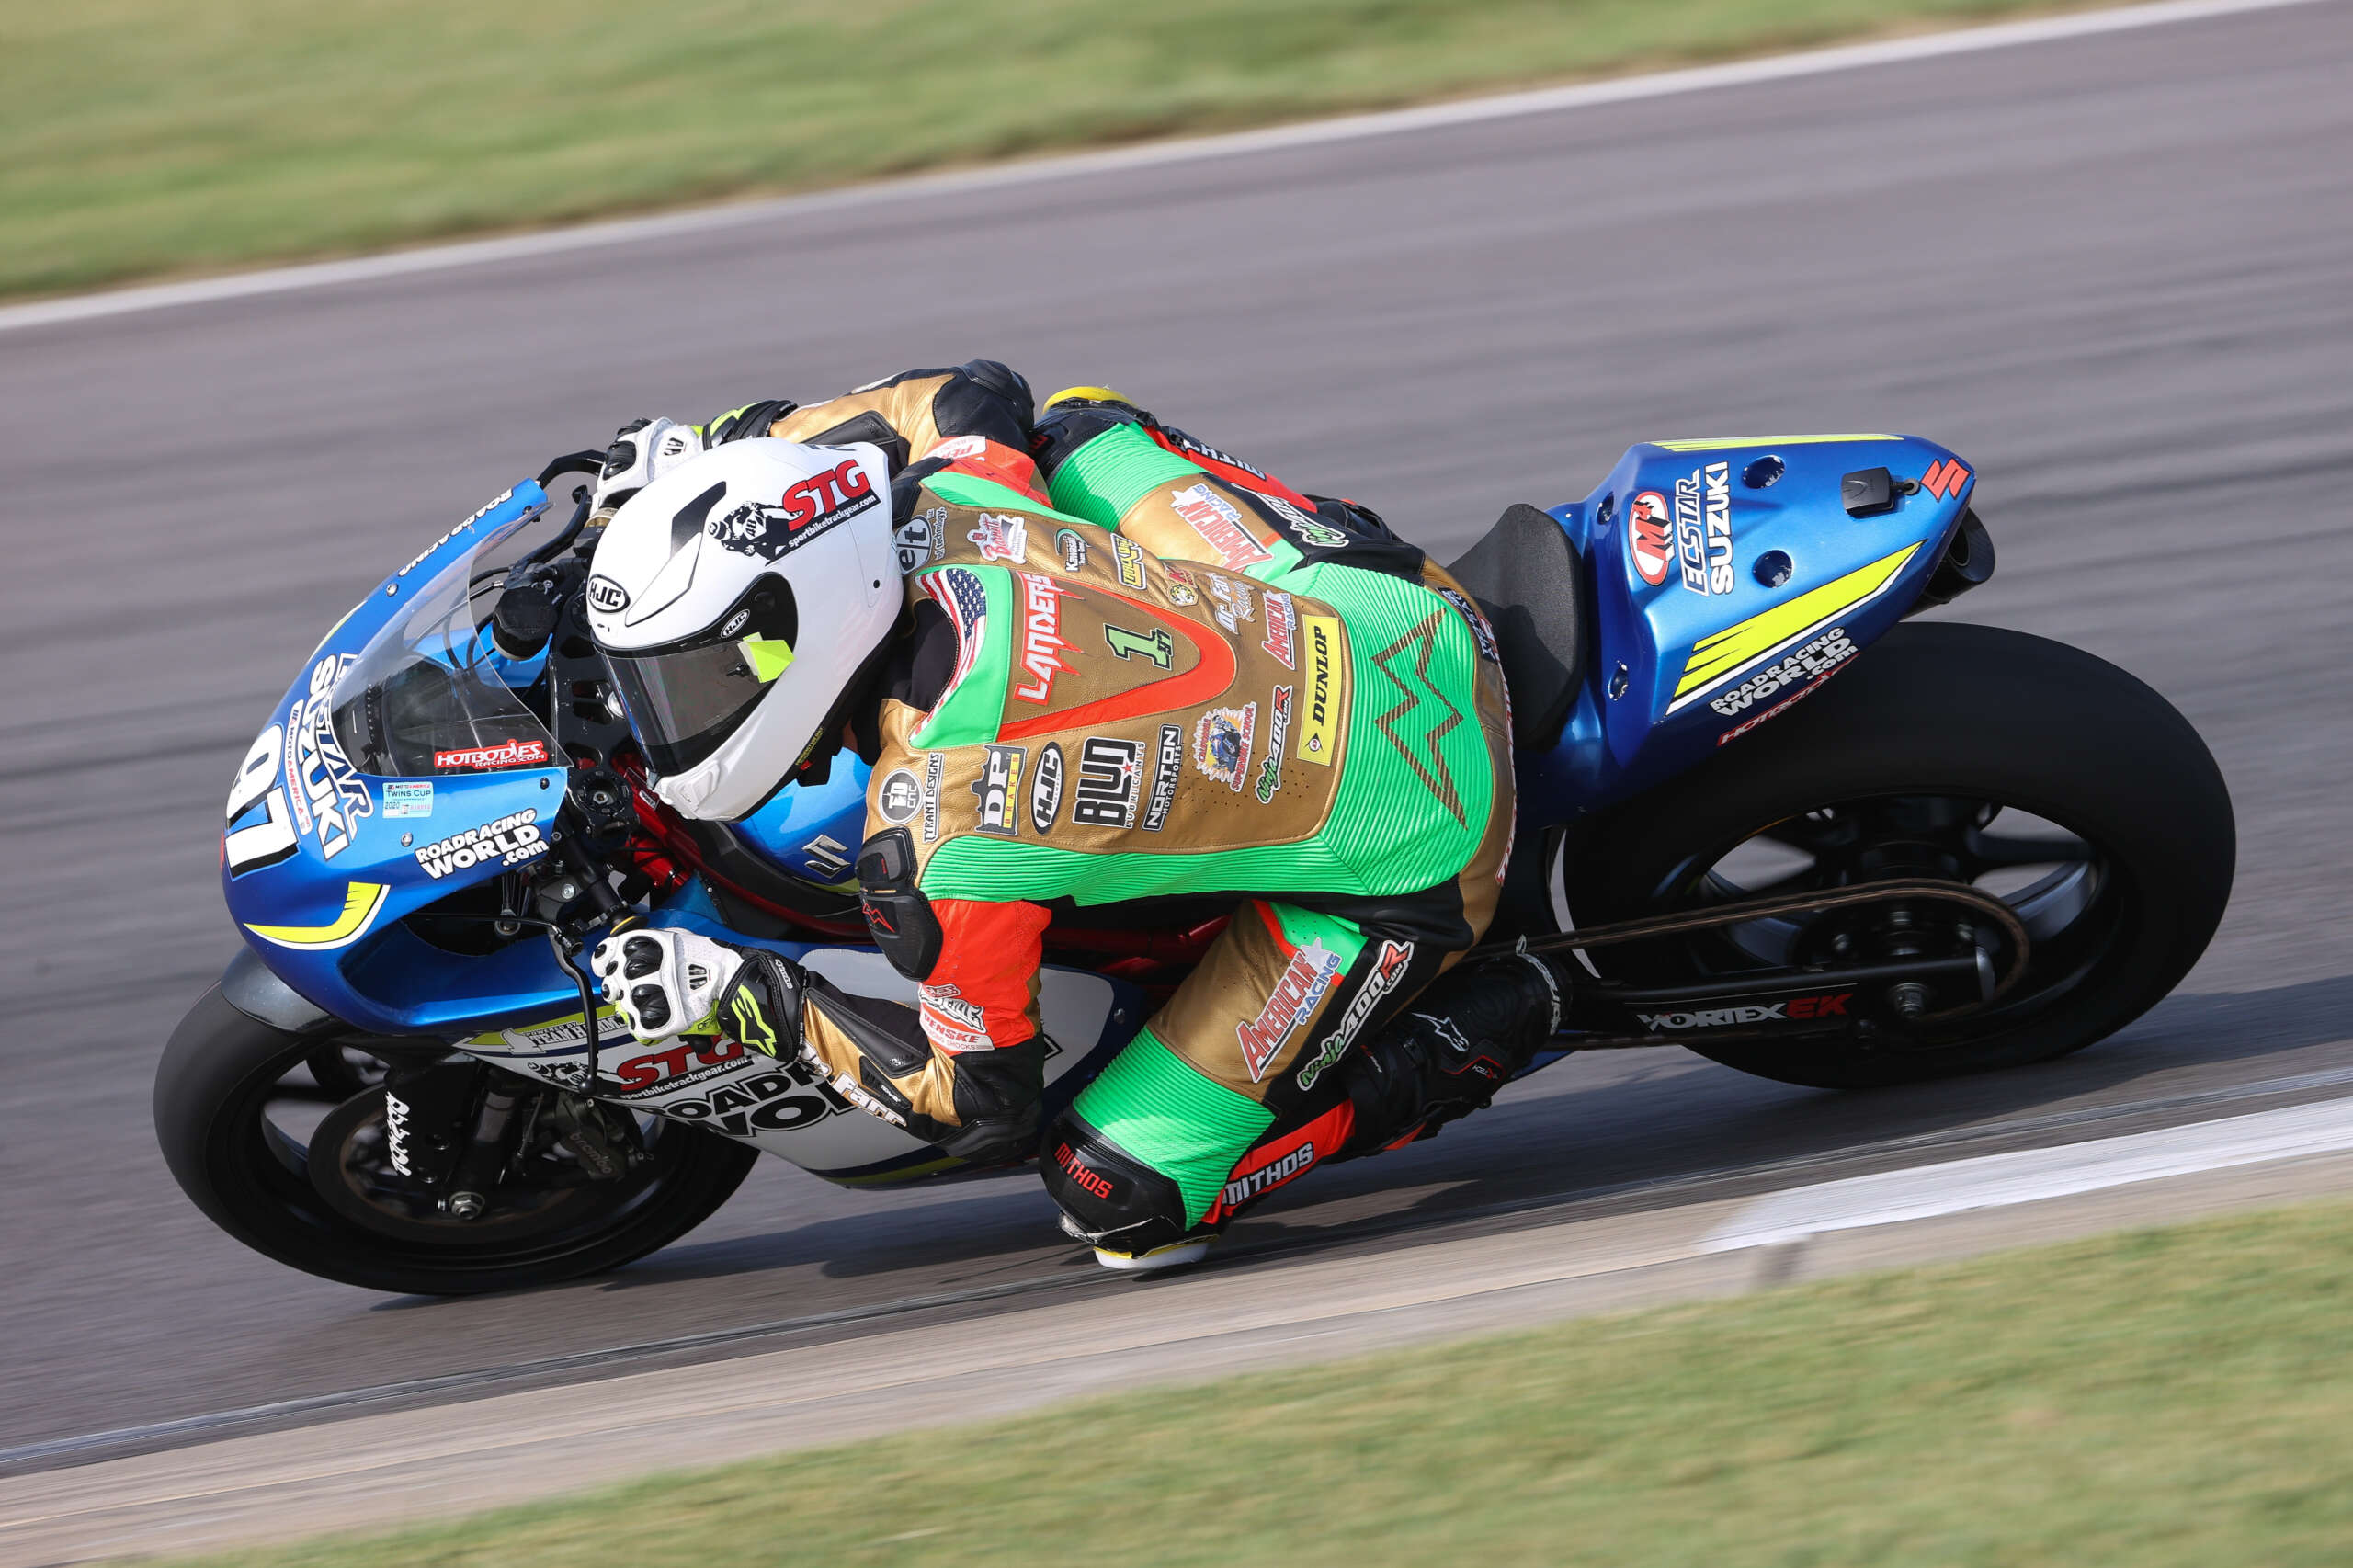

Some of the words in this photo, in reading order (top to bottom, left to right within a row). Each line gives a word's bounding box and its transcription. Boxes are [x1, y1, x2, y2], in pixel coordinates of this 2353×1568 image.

[782, 459, 870, 532] STG
[788, 494, 876, 548] sportbiketrackgear.com
[1194, 484, 1241, 522] RACING
[983, 515, 1012, 558] Barnett
[1065, 535, 1079, 571] Kawasaki
[1179, 500, 1274, 572] AMERICAN
[1633, 499, 1674, 562] M4
[1676, 469, 1710, 597] ECSTAR
[1705, 462, 1735, 595] SUZUKI
[589, 581, 622, 608] HJC
[1281, 594, 1296, 630] RACING
[725, 613, 746, 635] HJC
[1263, 597, 1294, 668] AMERICAN
[1313, 625, 1330, 726] DUNLOP
[1710, 627, 1845, 710] ROADRACING
[1716, 638, 1851, 716] WORLD
[1806, 645, 1859, 680] .com
[310, 654, 350, 860] SUZUKI
[437, 742, 540, 767] HOTBODIES
[475, 753, 545, 767] RACING.COM
[1199, 718, 1211, 763] CALIFORNIA
[1231, 739, 1251, 790] SUPERBIKE
[1241, 707, 1255, 741] SCHOOL
[226, 724, 300, 880] 97
[386, 790, 411, 798] TWINS
[926, 754, 939, 797] DESIGNS
[984, 751, 1008, 826] DP
[1005, 756, 1019, 824] BRAKES
[1037, 752, 1058, 824] HJC
[1126, 743, 1145, 828] LUBRICANTS
[1147, 730, 1176, 826] NORTON
[1162, 745, 1182, 814] MOTORSPORTS
[384, 801, 400, 810] 2020
[925, 800, 936, 842] TYRANT
[415, 809, 537, 863] ROADRACING
[421, 825, 540, 880] WORLD
[503, 840, 550, 866] .com
[1295, 953, 1341, 1023] RACING
[1636, 1003, 1787, 1031] VORTEX
[1786, 994, 1853, 1018] EK
[530, 1026, 574, 1046] TEAM
[923, 1012, 981, 1044] PENSKE
[1239, 952, 1319, 1081] AMERICAN
[617, 1035, 744, 1091] STG
[1054, 1142, 1113, 1199] MITHOS
[1222, 1142, 1313, 1205] MITHOS
